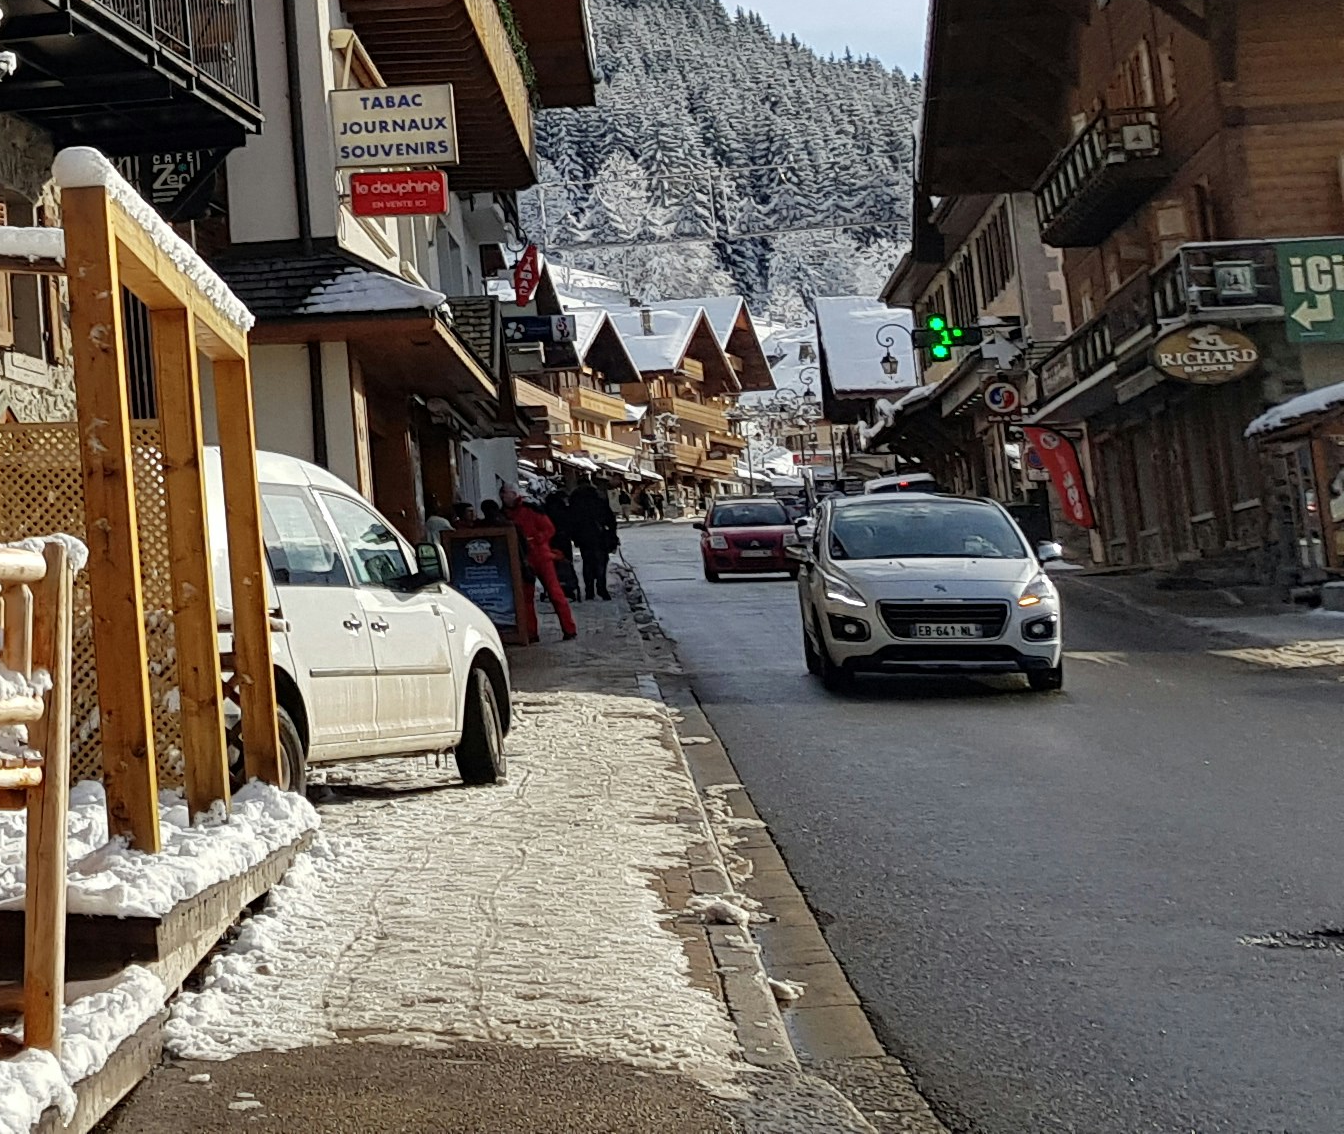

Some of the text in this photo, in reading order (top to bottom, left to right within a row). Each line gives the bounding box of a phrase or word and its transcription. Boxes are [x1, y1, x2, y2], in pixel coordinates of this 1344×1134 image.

[360, 94, 423, 110] TABAC
[340, 117, 448, 135] JOURNAUX
[340, 140, 449, 159] SOUVENIRS
[353, 182, 369, 194] le
[372, 199, 426, 208] EN VENTE ICI
[1160, 348, 1259, 366] RICHARD
